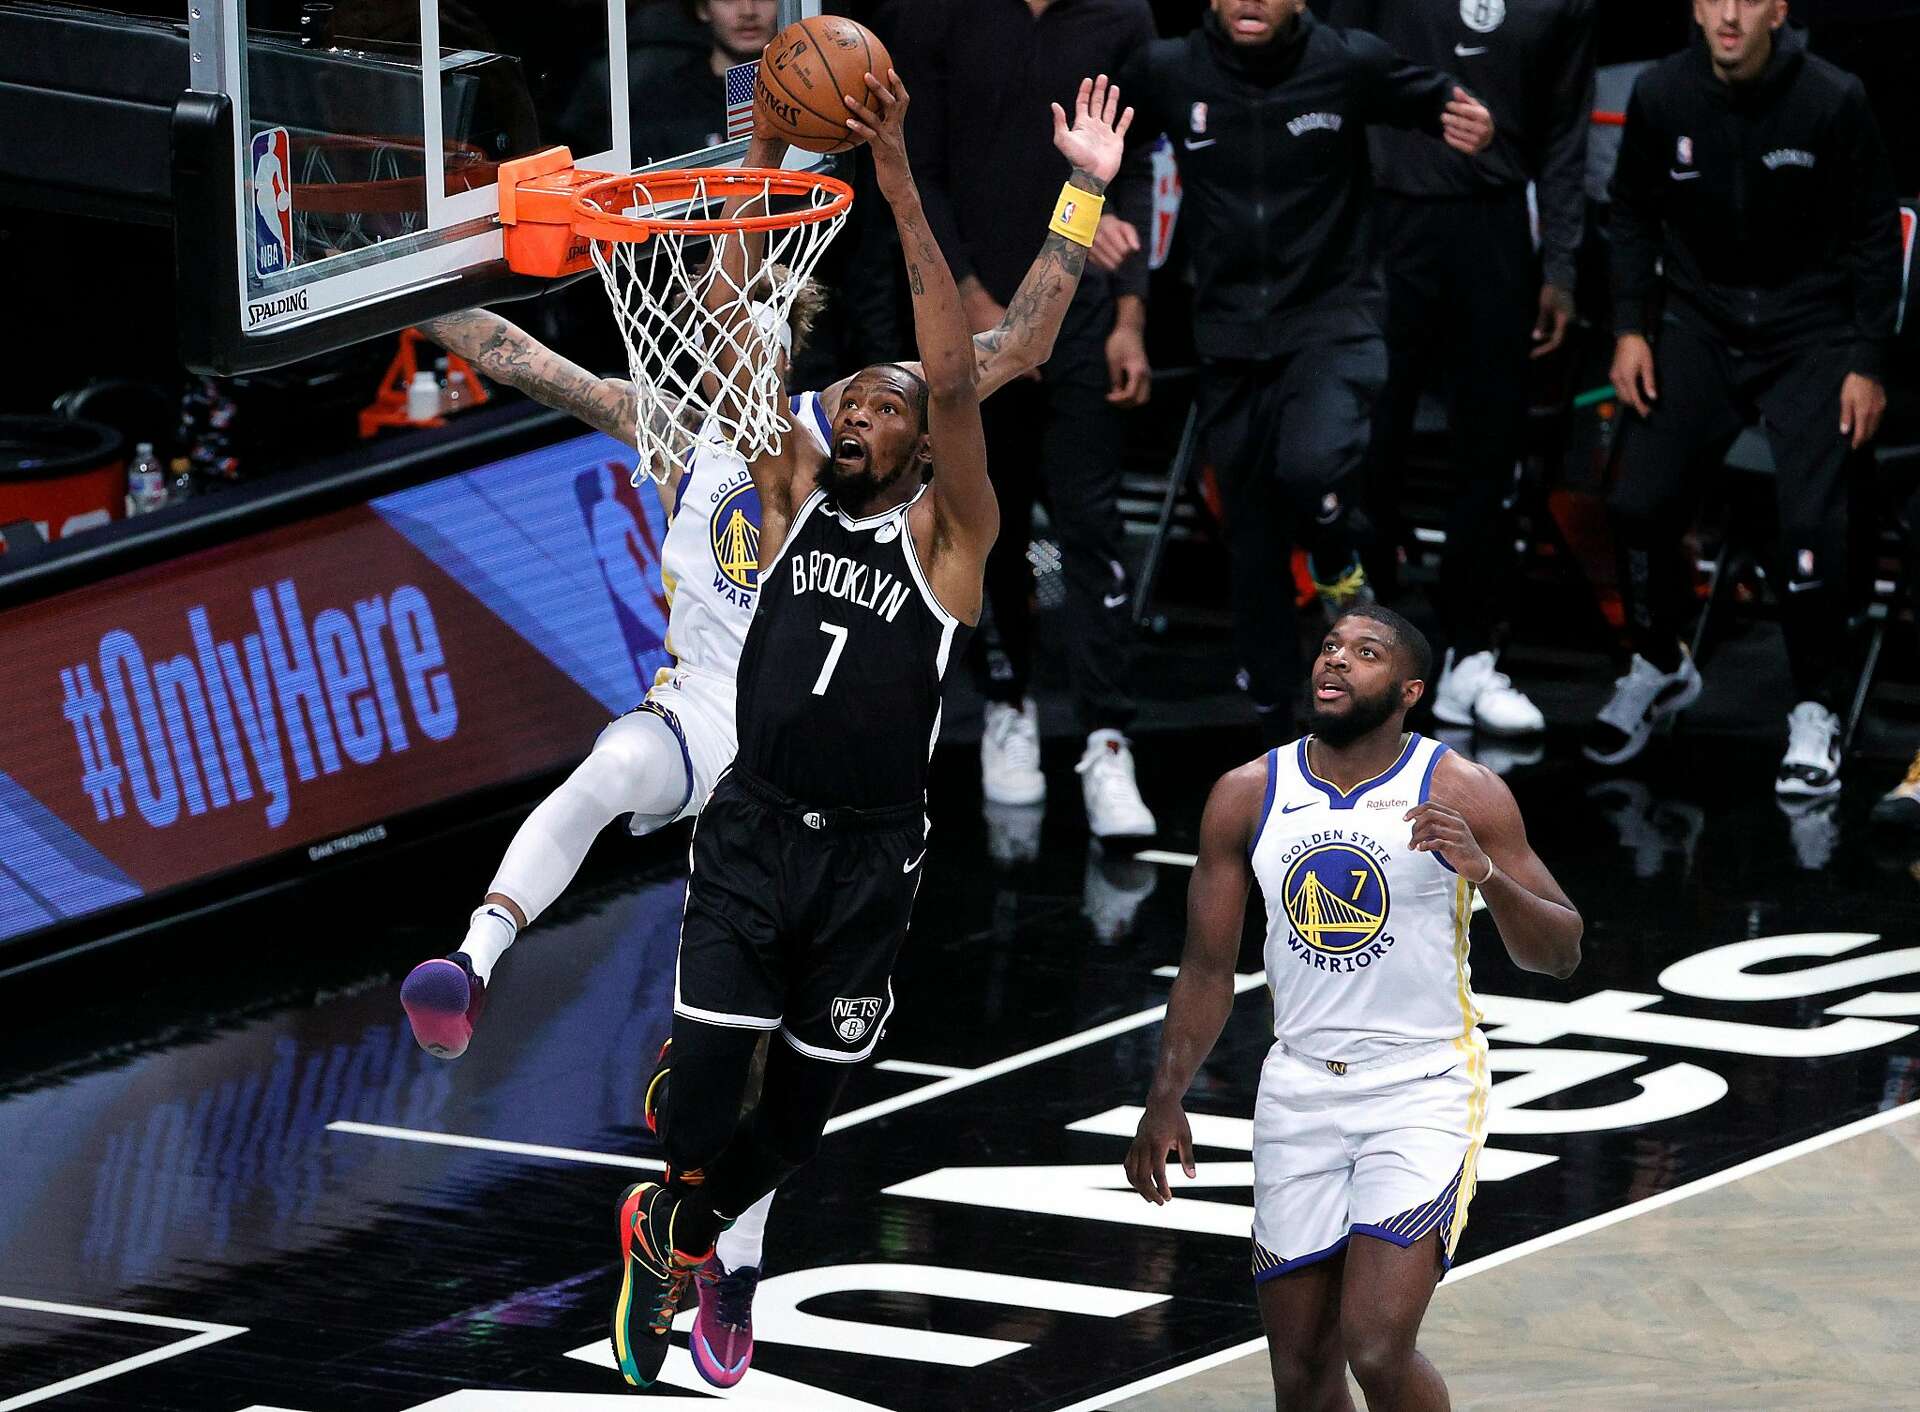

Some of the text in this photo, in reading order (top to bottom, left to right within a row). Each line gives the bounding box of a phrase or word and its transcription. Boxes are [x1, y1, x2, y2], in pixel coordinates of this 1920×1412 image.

[260, 242, 280, 269] NBA
[248, 287, 309, 327] SPALDING
[710, 470, 748, 503] GOLD
[712, 570, 754, 611] WAR
[791, 549, 911, 624] BROOKLYN
[811, 620, 849, 697] 7
[59, 577, 459, 829] #OnlyHere
[1366, 799, 1408, 810] Rakuten
[1281, 829, 1392, 865] GOLDEN STATE
[1351, 870, 1369, 901] 7
[1286, 930, 1396, 973] WARRIORS
[833, 1000, 879, 1018] NETS
